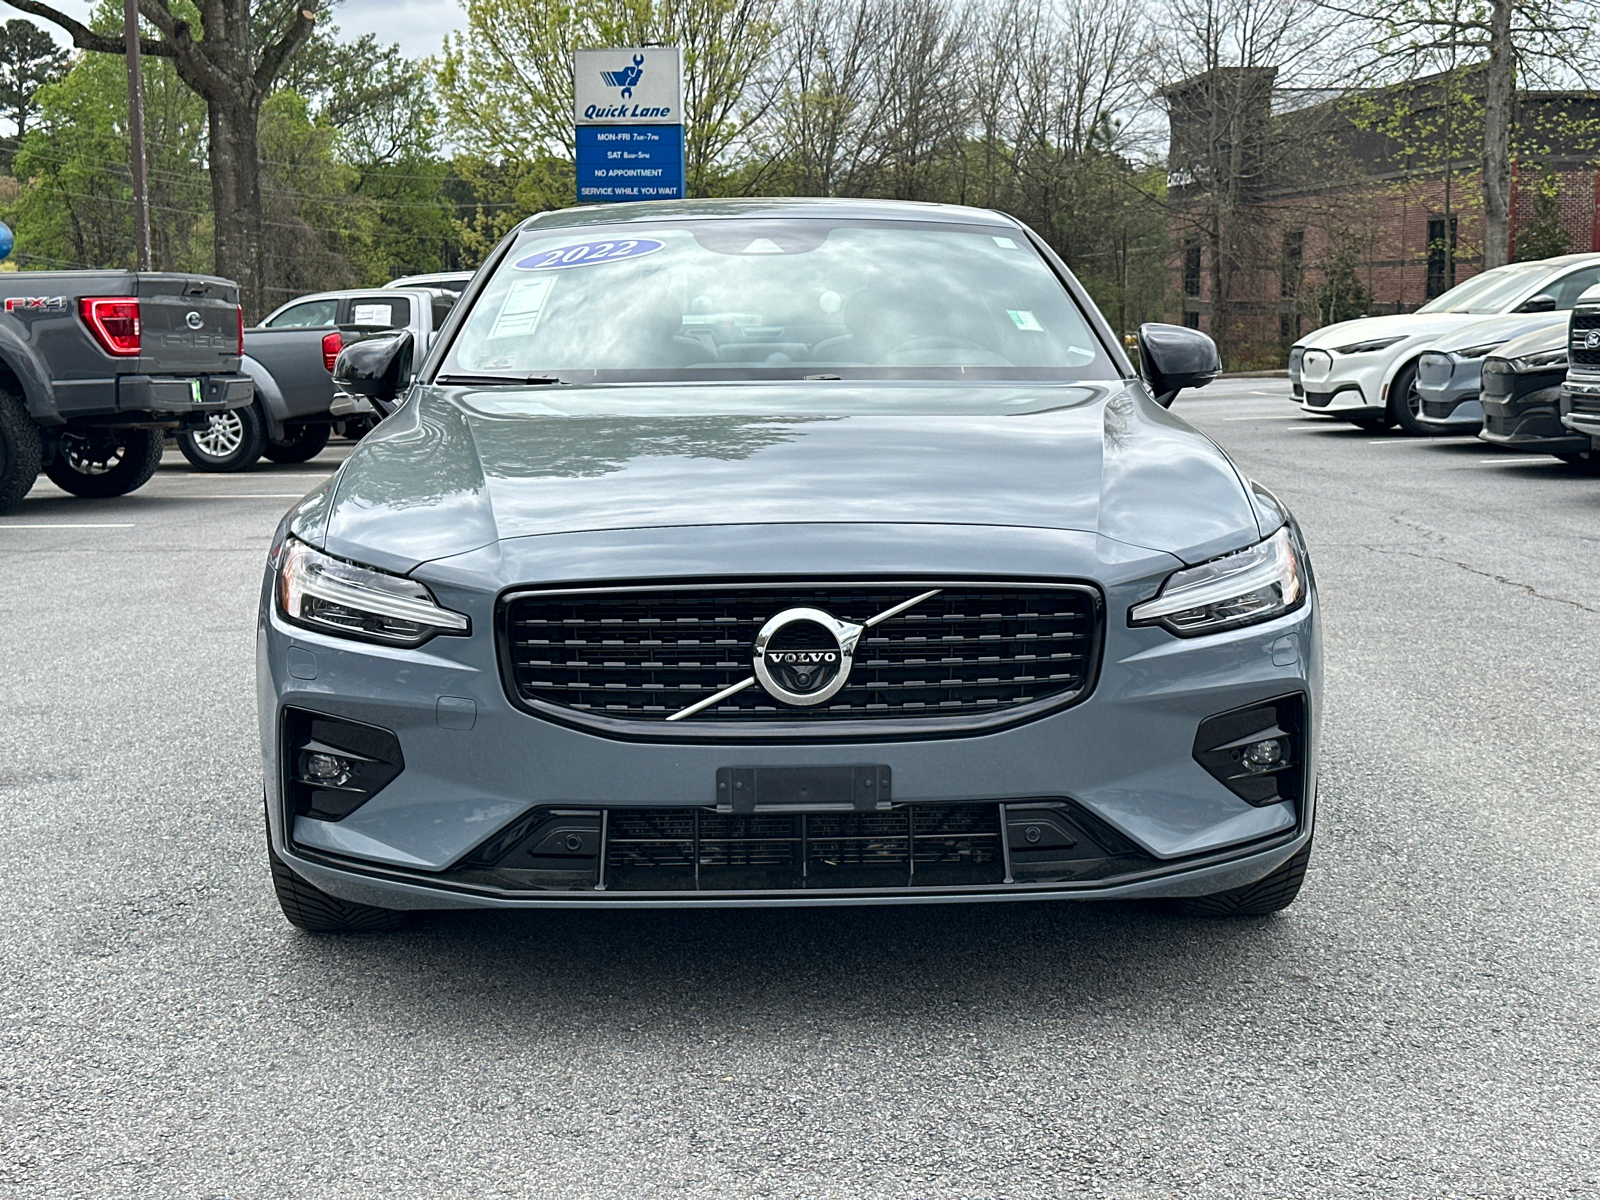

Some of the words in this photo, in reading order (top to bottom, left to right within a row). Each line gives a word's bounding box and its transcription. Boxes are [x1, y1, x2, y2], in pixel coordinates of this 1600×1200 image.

[584, 104, 629, 119] Quick
[630, 104, 671, 118] Lane
[597, 133, 631, 141] MON-FRI
[607, 151, 622, 159] SAT
[594, 169, 607, 177] NO
[608, 168, 663, 177] APPOINTMENT
[581, 187, 613, 195] SERVICE
[614, 187, 639, 195] WHILE
[640, 187, 657, 195] YOU
[658, 187, 678, 195] WAIT
[534, 240, 639, 268] 2022
[4, 295, 68, 314] FX4
[768, 652, 837, 663] VOLVO
